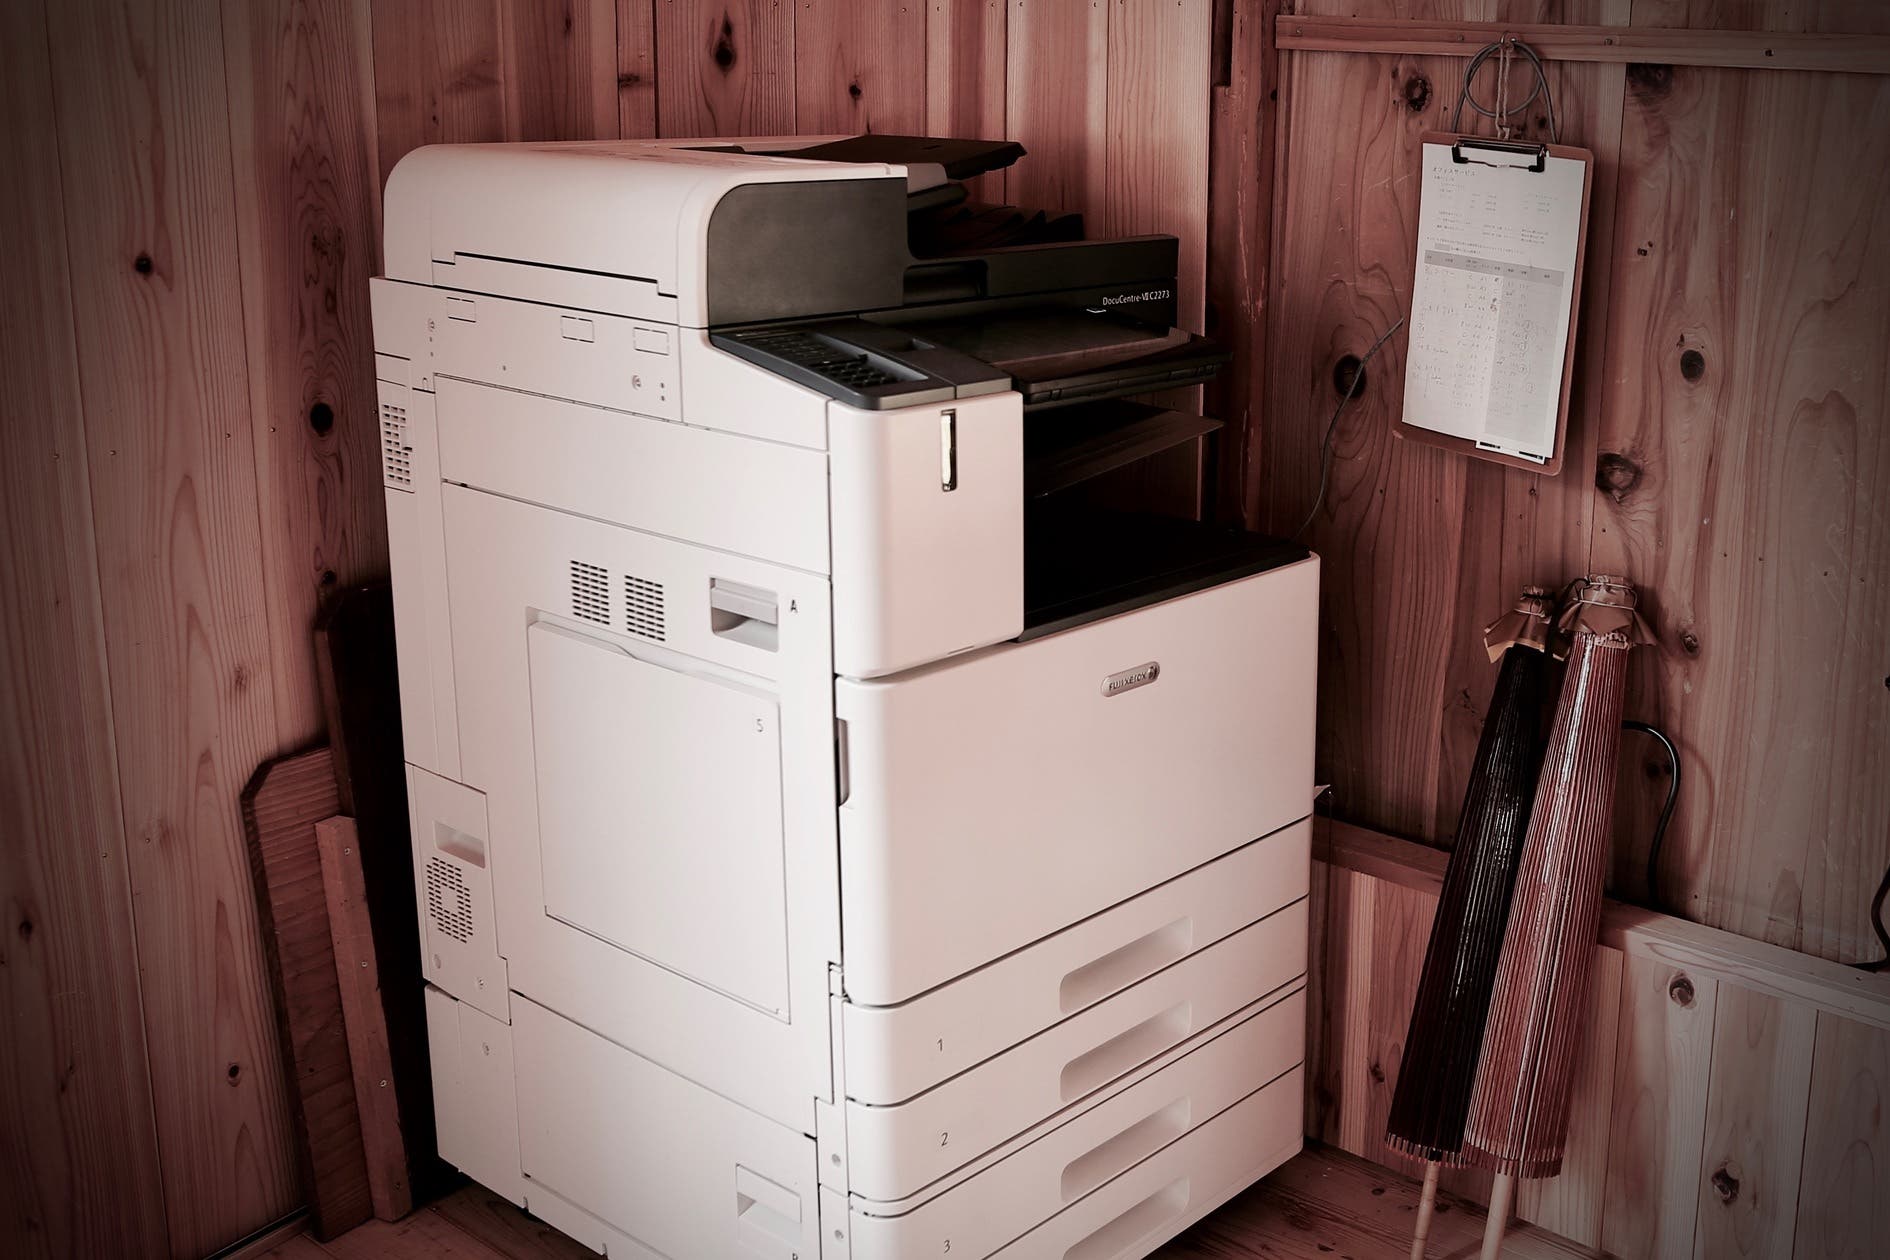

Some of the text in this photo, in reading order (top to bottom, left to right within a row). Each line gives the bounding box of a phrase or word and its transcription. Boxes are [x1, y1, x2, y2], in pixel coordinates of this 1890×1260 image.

[1149, 289, 1170, 300] C2273
[790, 599, 798, 613] A
[937, 1038, 943, 1052] 1
[941, 1132, 949, 1147] 2
[944, 1239, 951, 1254] 3
